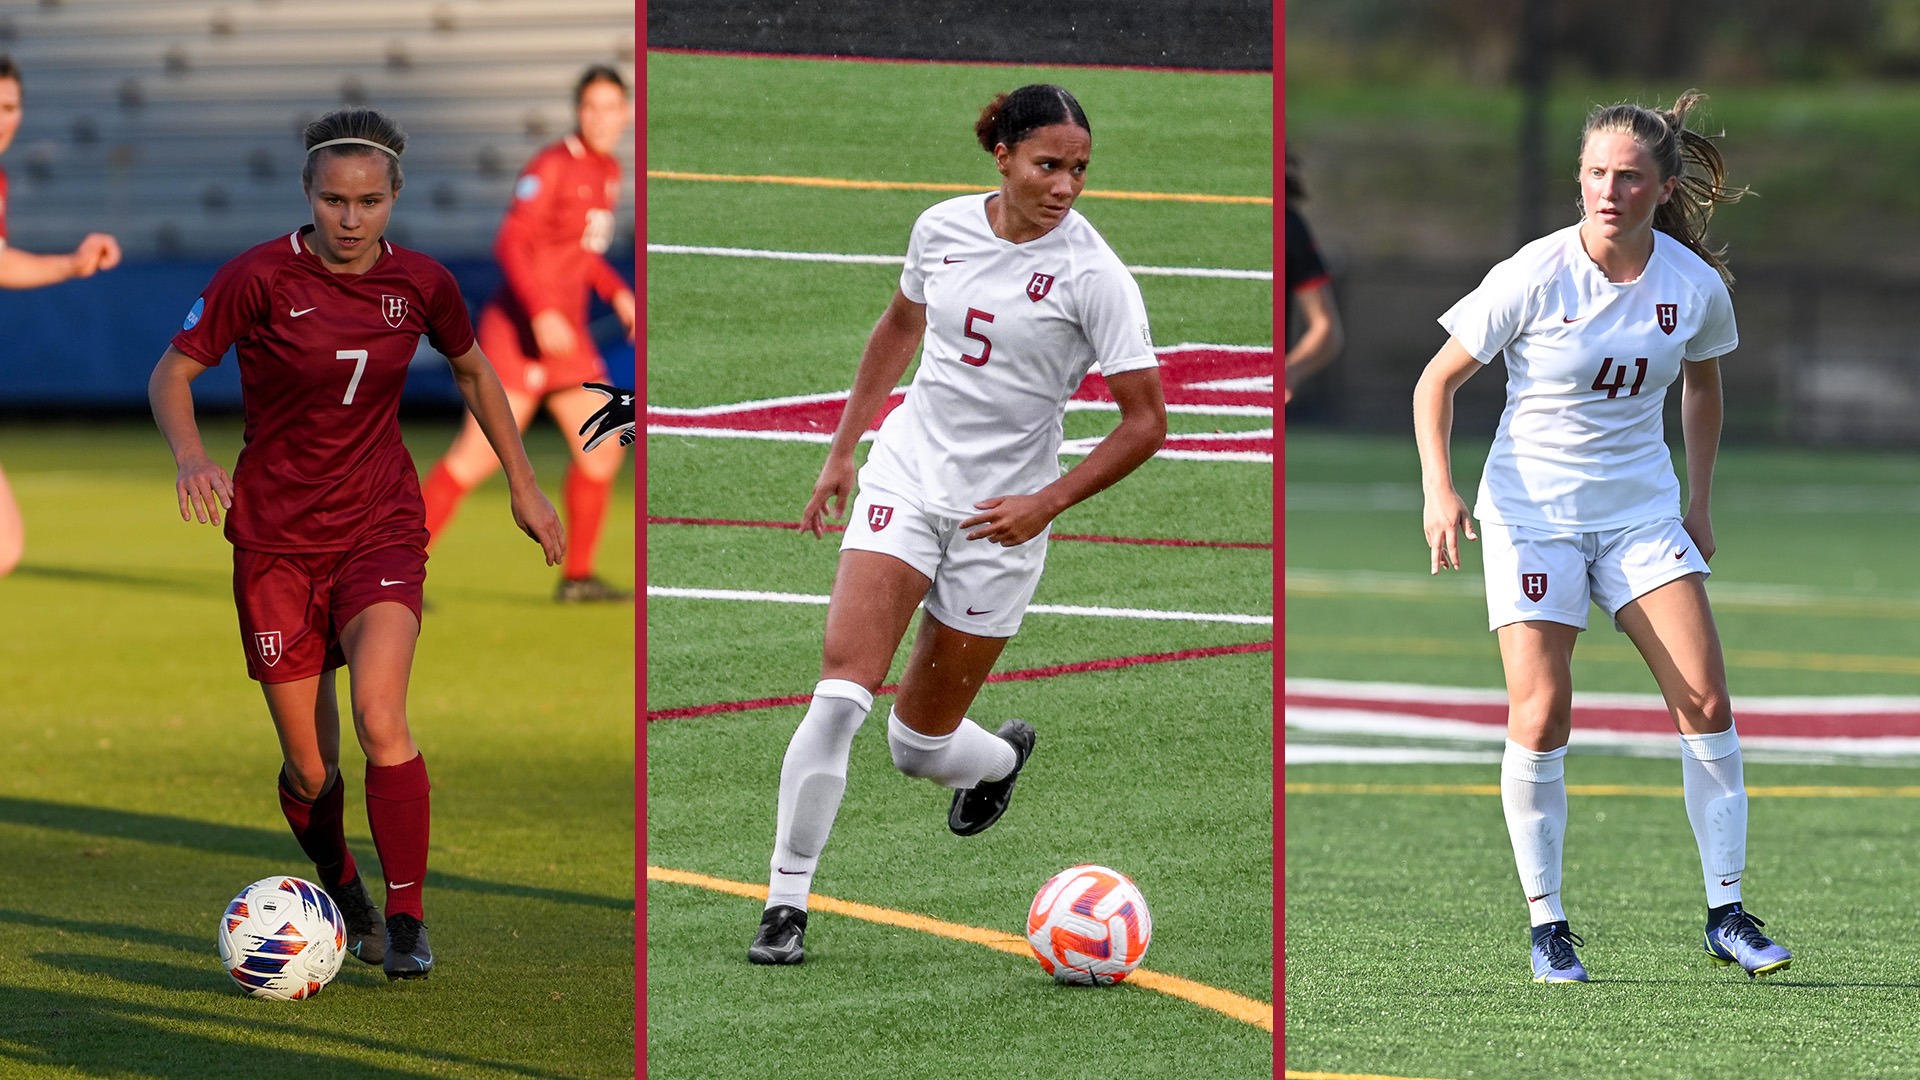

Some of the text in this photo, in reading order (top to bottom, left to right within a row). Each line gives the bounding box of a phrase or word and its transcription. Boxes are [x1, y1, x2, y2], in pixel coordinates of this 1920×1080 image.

[1029, 275, 1049, 296] H
[388, 298, 402, 318] H
[1661, 306, 1674, 326] H
[960, 307, 995, 367] 5
[336, 349, 368, 405] 7
[1591, 357, 1648, 399] 41
[870, 507, 889, 527] H
[1527, 576, 1543, 594] H
[260, 636, 277, 656] H
